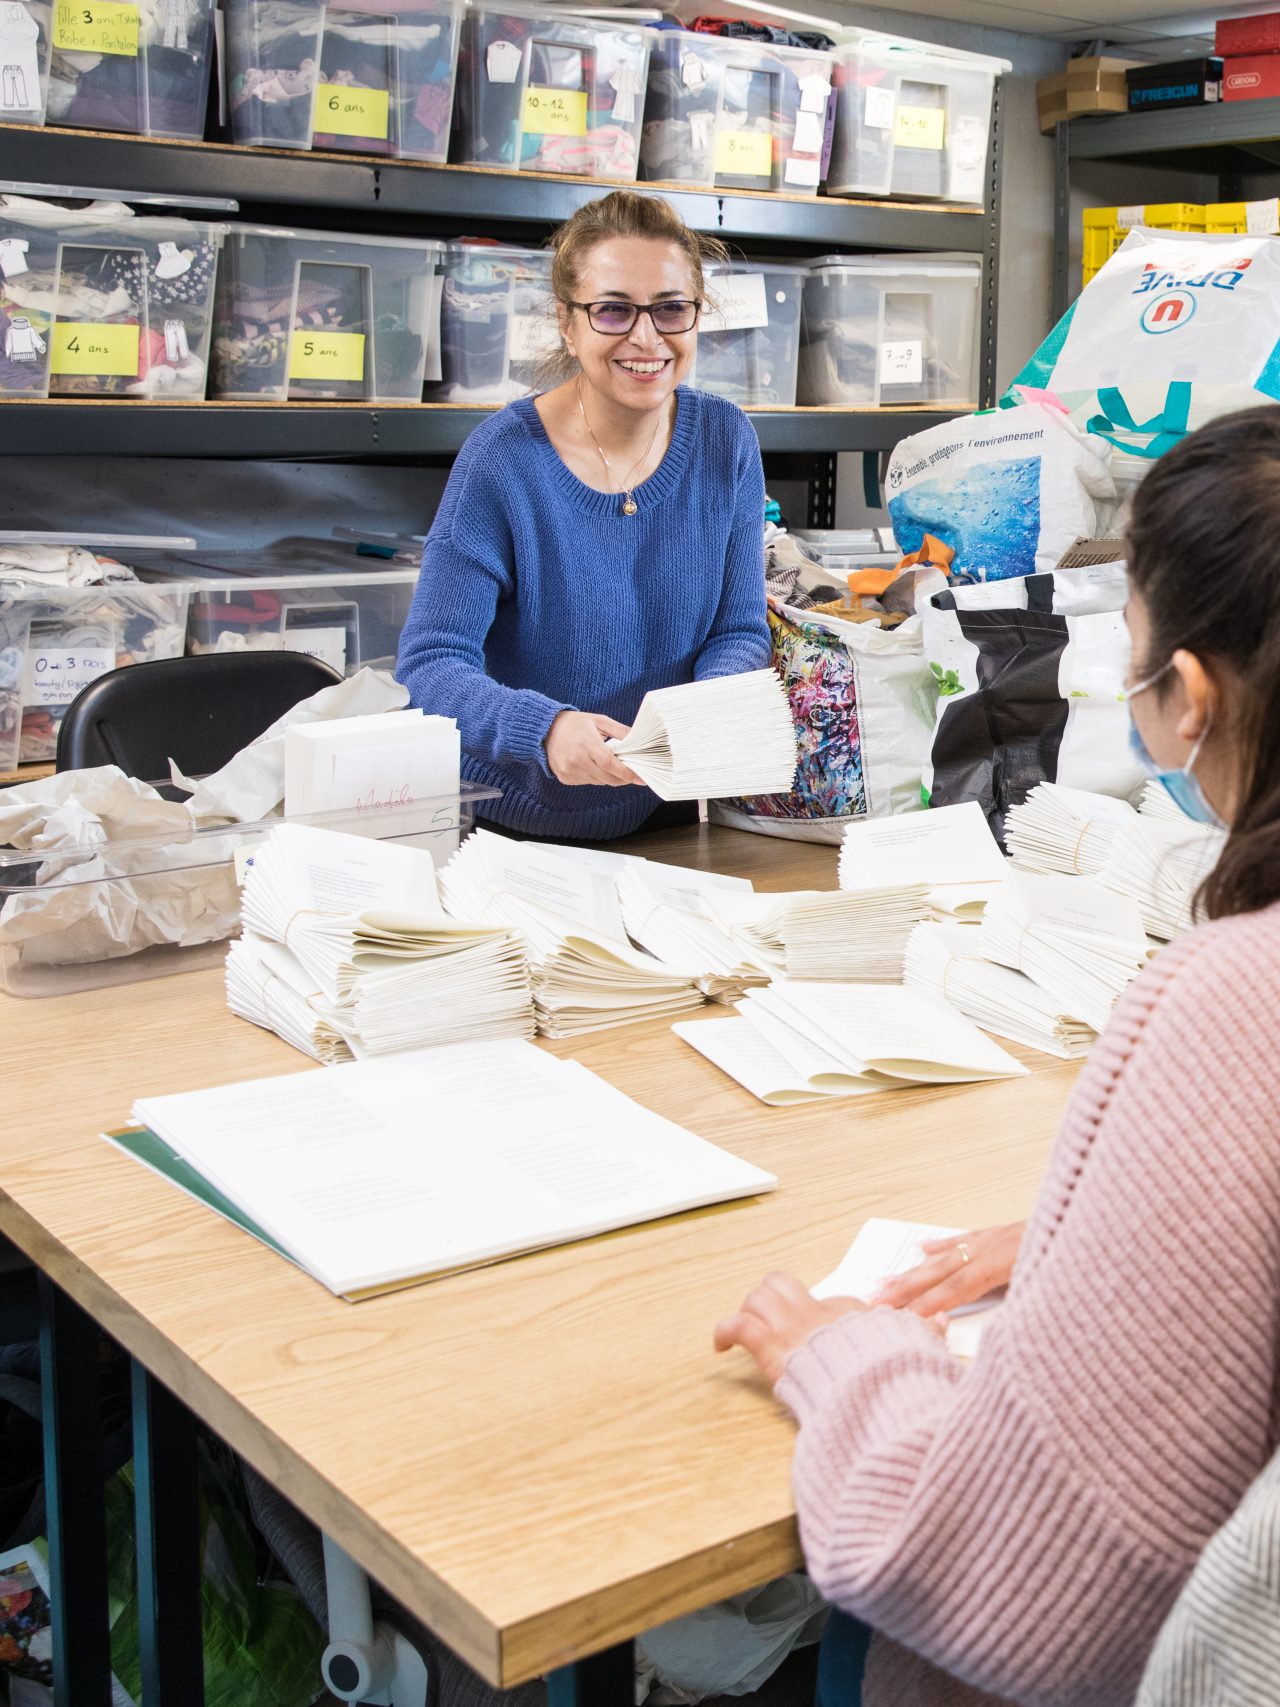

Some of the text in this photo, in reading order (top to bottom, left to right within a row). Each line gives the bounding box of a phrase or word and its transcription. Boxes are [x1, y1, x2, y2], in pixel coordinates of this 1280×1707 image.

[82, 10, 94, 24] 3
[328, 95, 365, 114] 6 ans
[550, 99, 565, 110] 12
[1132, 271, 1244, 294] DRVE
[1151, 299, 1184, 322] U
[66, 336, 109, 354] 4 ans
[303, 342, 315, 356] 5
[968, 429, 1044, 448] l'environnement
[35, 658, 48, 672] 0
[66, 657, 76, 669] 3
